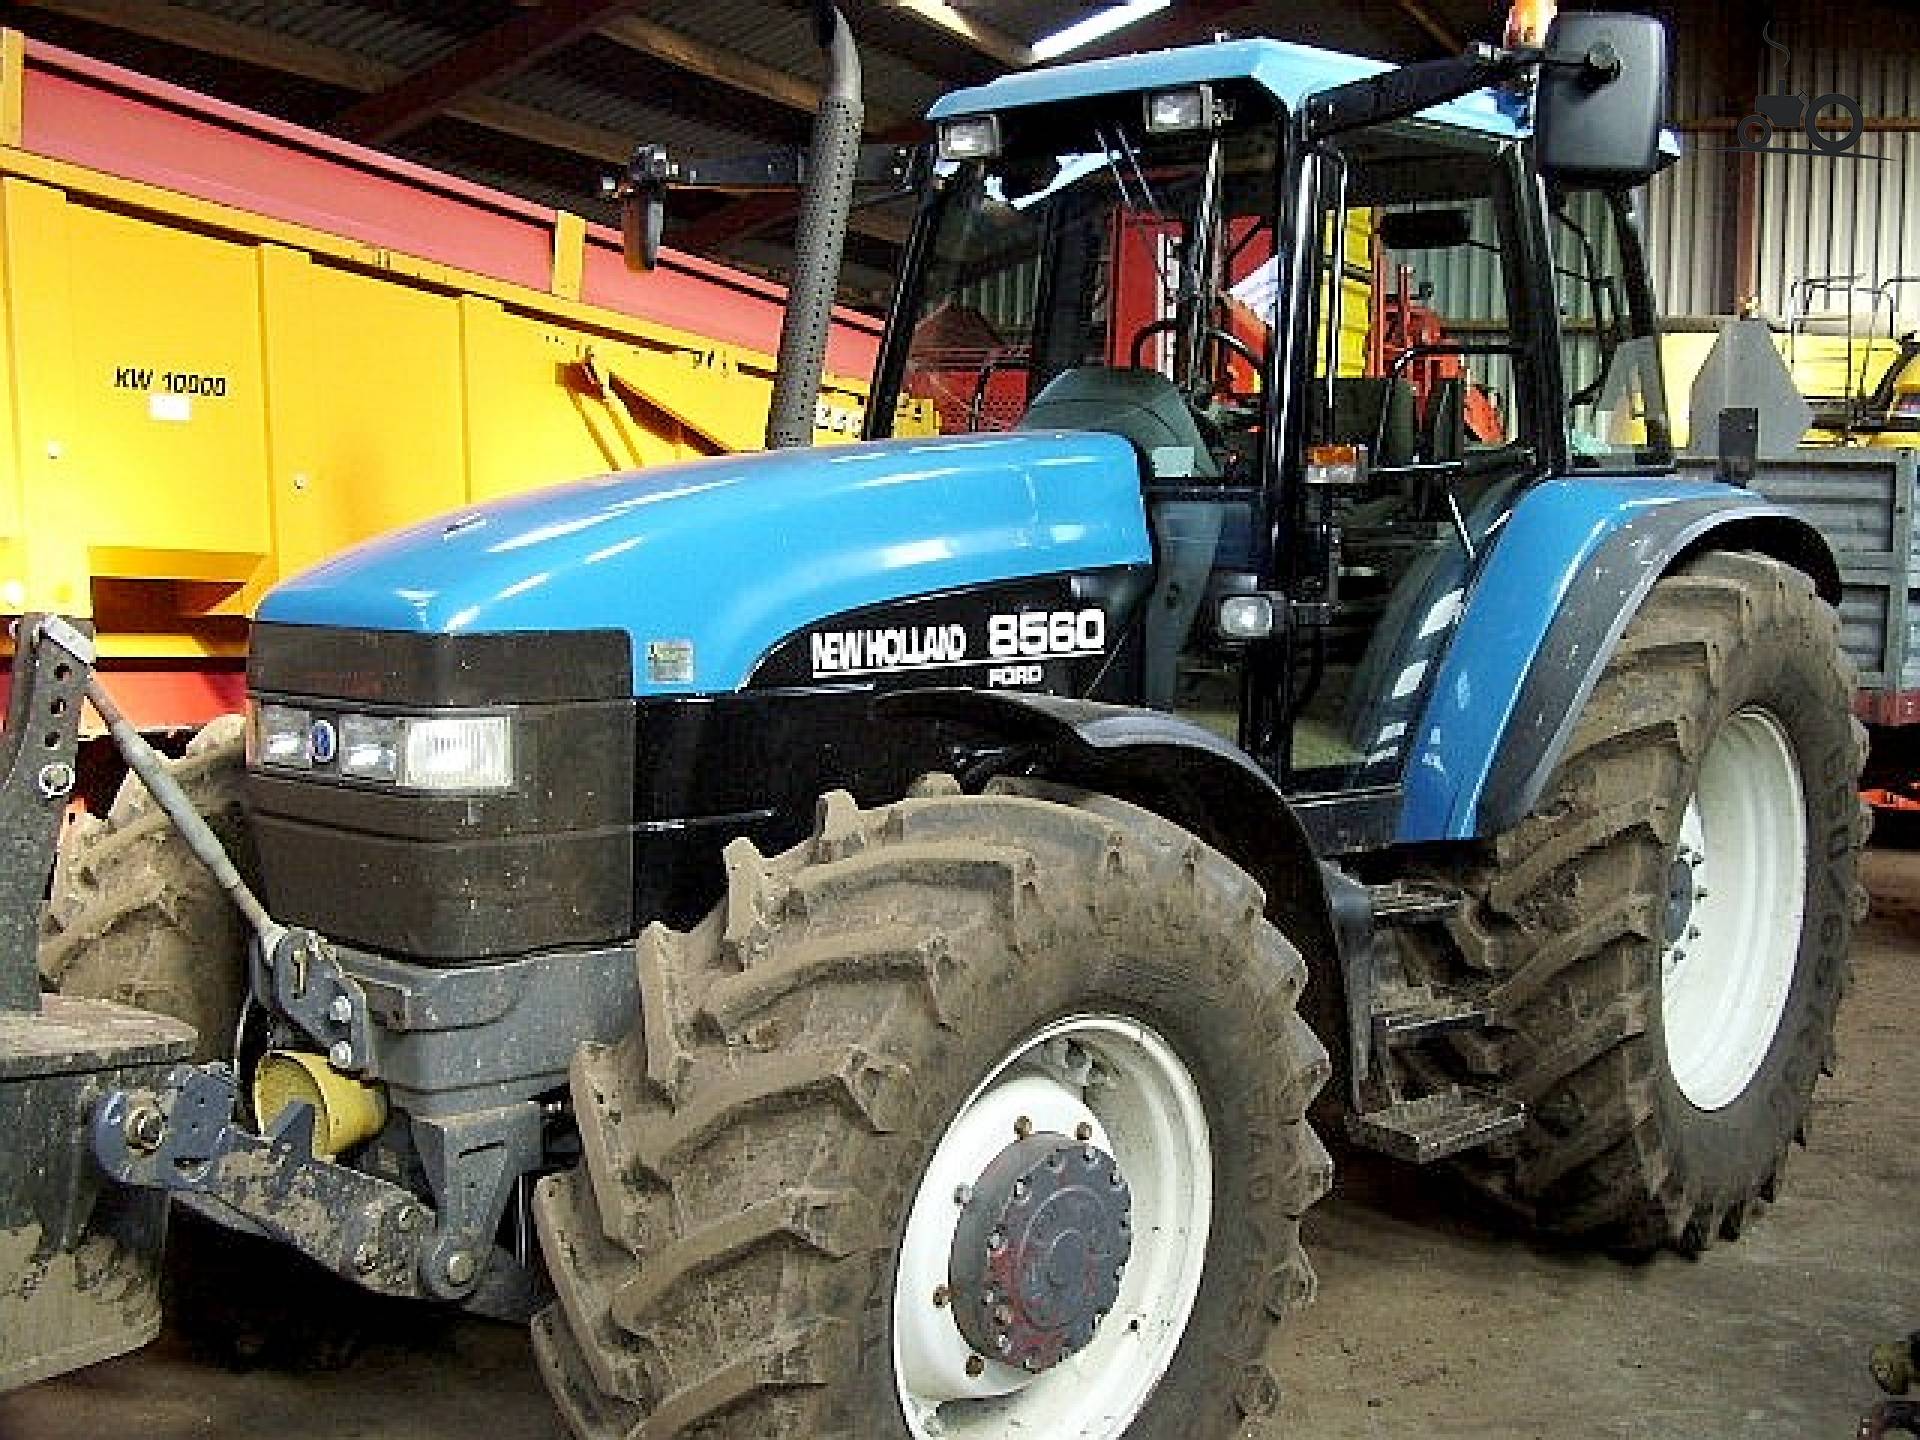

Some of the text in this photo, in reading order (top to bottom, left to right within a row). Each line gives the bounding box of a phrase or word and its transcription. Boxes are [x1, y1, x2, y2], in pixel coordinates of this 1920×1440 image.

[114, 366, 226, 397] KW 10000
[811, 608, 1106, 671] NEW HOLLAND 8560
[989, 665, 1043, 688] FORD
